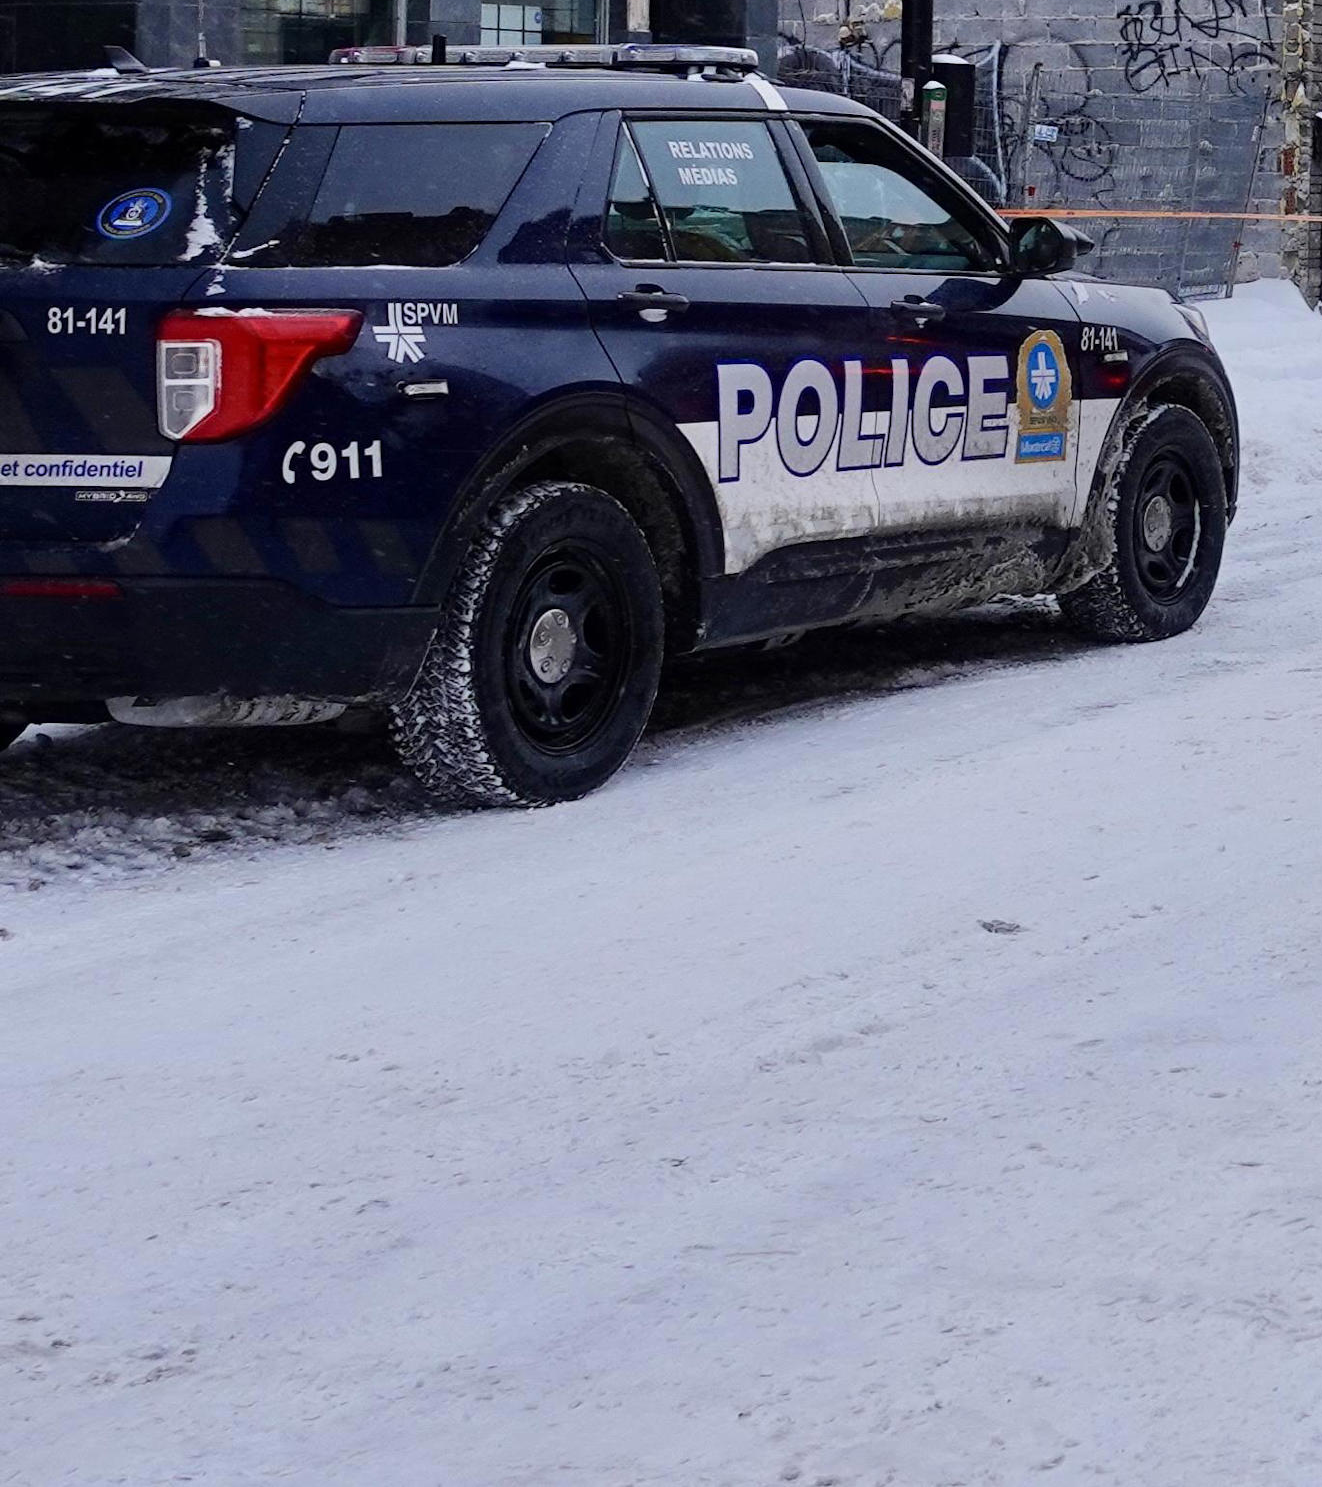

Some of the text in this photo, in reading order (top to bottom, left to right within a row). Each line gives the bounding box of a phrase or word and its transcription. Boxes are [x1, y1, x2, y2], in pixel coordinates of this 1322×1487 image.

[668, 141, 754, 159] RELATIONS
[678, 164, 738, 185] MÉDIAS
[48, 307, 127, 335] 81-141
[403, 302, 459, 325] SPVM
[1080, 327, 1119, 351] 81-141
[716, 354, 1009, 484] POLICE
[1, 460, 144, 478] et confidentiel
[310, 440, 383, 481] 911
